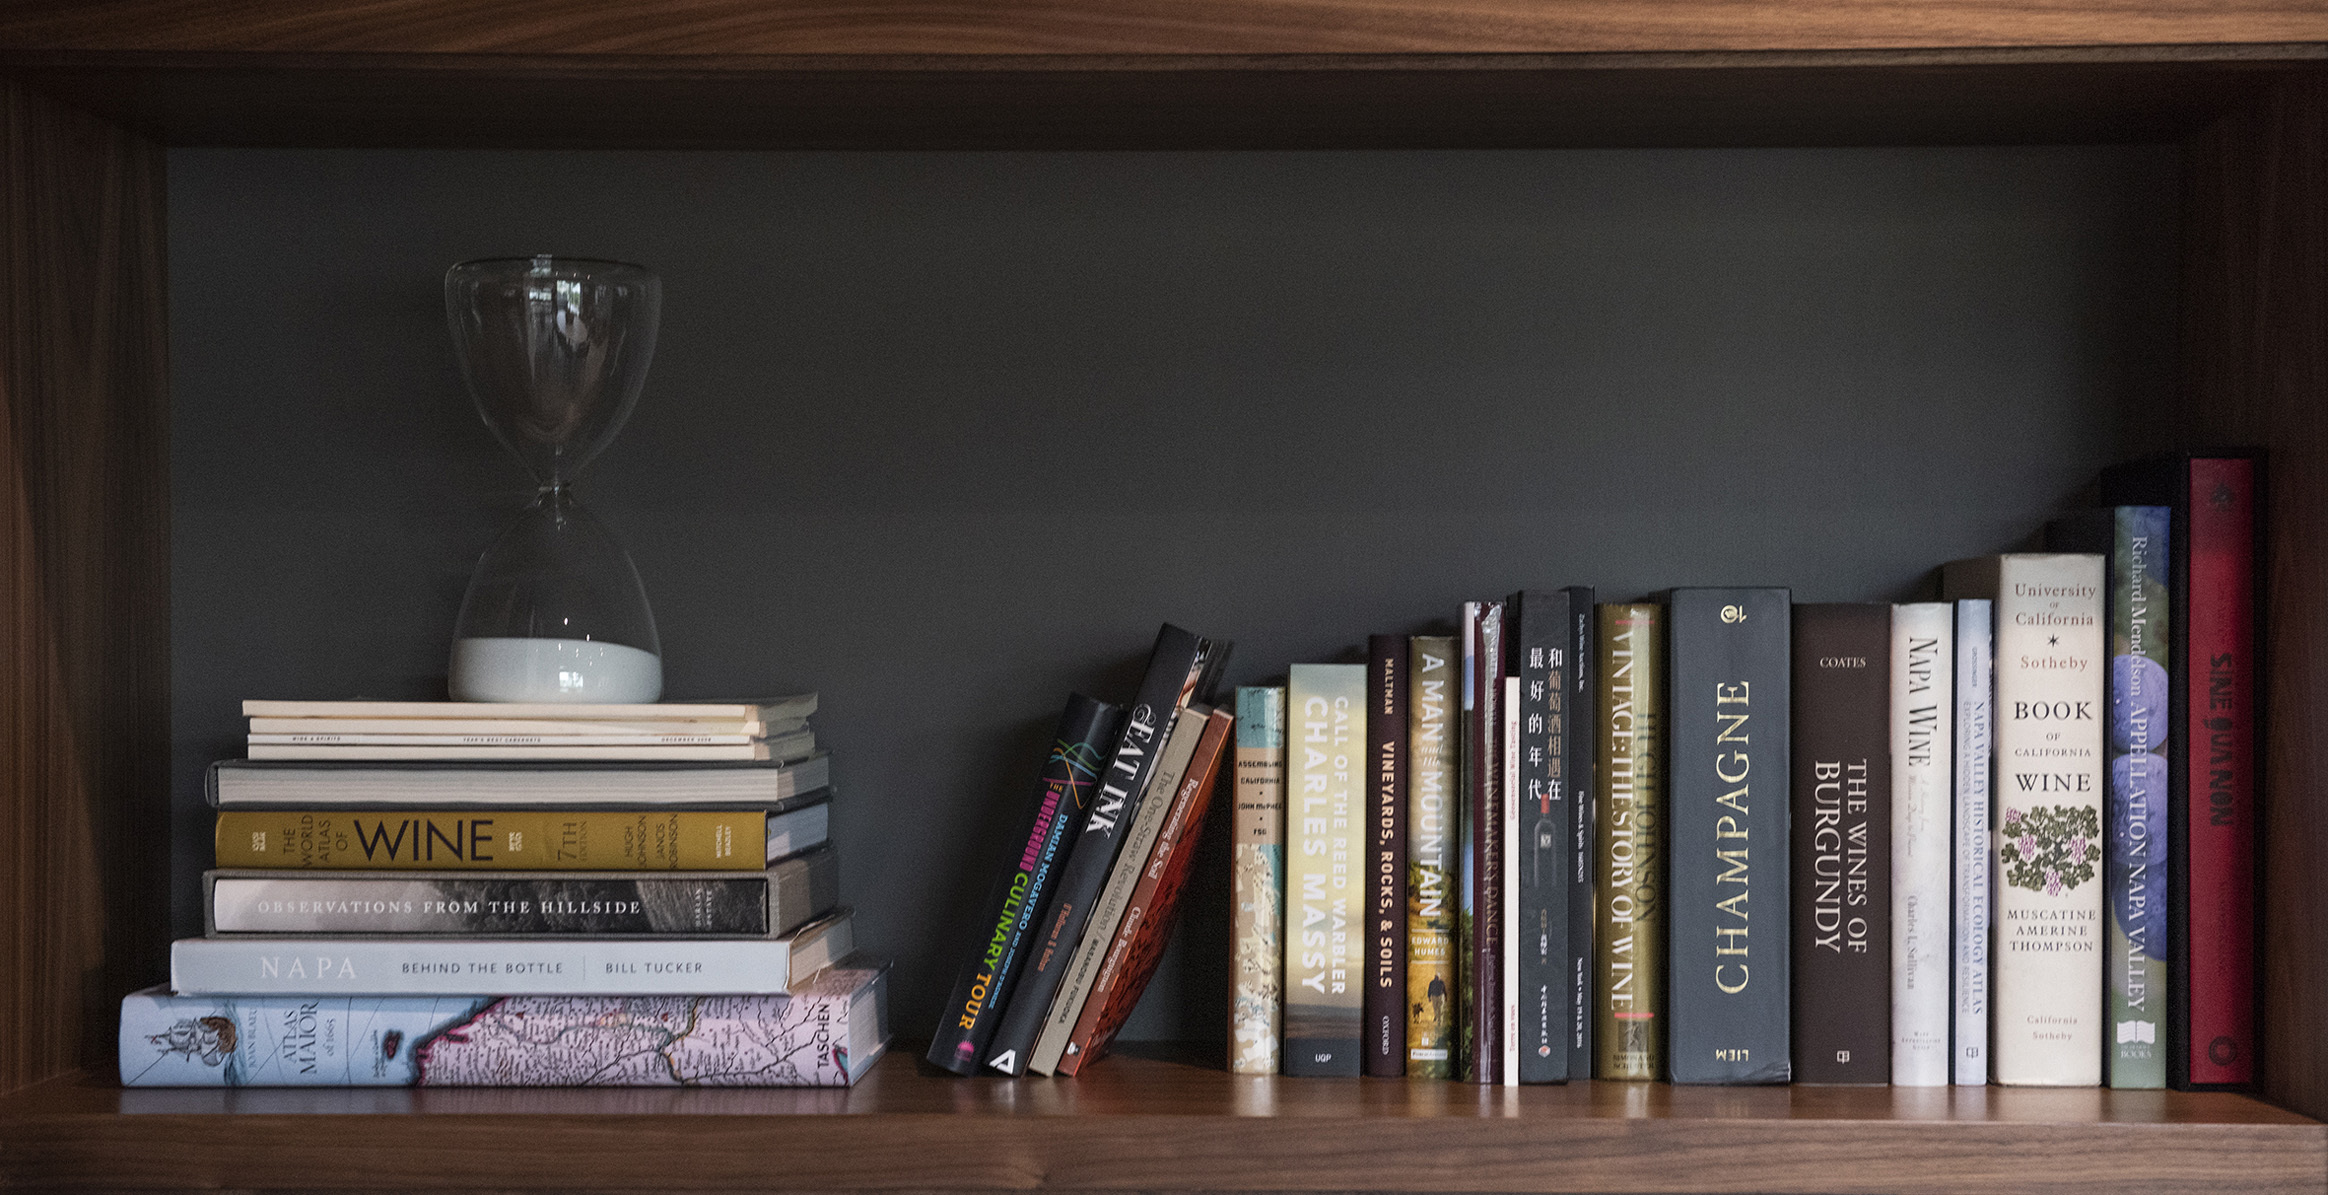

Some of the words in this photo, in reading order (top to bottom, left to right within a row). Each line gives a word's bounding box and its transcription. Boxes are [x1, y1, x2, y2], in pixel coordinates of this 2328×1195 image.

[2015, 583, 2097, 600] University
[2130, 536, 2148, 602] Richard
[2015, 612, 2094, 626] California
[1421, 653, 1445, 673] A
[1819, 656, 1867, 668] COATES
[1908, 635, 1938, 695] NAPA
[2020, 656, 2089, 670] Sotheby
[2130, 605, 2147, 696] Mendelson
[1384, 658, 1393, 716] MALTMAN
[1611, 630, 1633, 752] VINTAGE:
[2208, 652, 2232, 710] SINE
[1333, 696, 1349, 747] CALL
[1421, 680, 1445, 741] MAN
[1528, 647, 1544, 801] 最好的年代
[1547, 647, 1563, 801] 和葡萄酒相遇在
[1907, 703, 1937, 767] WINE
[1973, 701, 1984, 739] NAPA
[2014, 701, 2093, 720] BOOK
[2045, 732, 2061, 741] OF
[1113, 705, 1155, 781] EAT
[1238, 760, 1283, 768] ASSEMBLING
[1635, 712, 1656, 796] HUGH
[2014, 748, 2091, 757] CALIFORNIA
[2203, 717, 2233, 764] QUA
[1049, 781, 1063, 792] THE
[1155, 770, 1176, 795] The
[1240, 776, 1281, 785] CALIFORNIA
[1303, 696, 1328, 857] CHARLES
[1333, 754, 1349, 783] OF
[1380, 740, 1395, 847] VINEYARDS,
[1611, 754, 1633, 809] THE
[1846, 758, 1867, 814] THE
[1973, 743, 1984, 797] VALLEY
[2015, 773, 2092, 792] WINE
[2129, 701, 2148, 857] APPELLATION
[1086, 783, 1128, 838] INK
[1162, 778, 1199, 841] Regenerating
[1238, 802, 1255, 811] JOHN
[1333, 788, 1348, 823] THE
[2208, 769, 2233, 826] NON
[283, 827, 295, 854] THE
[300, 814, 313, 866] WORLD
[318, 819, 330, 862] ATLAS
[335, 831, 348, 851] OF
[353, 820, 493, 862] WINE
[557, 822, 577, 861] 7TH
[624, 826, 634, 857] HUGH
[636, 814, 647, 868] JOHNSON
[655, 823, 665, 859] JANCIS
[668, 813, 678, 868] ROBINSON
[1019, 790, 1060, 872] UNDERGROUND
[1044, 813, 1069, 862] DAMIAN
[1128, 795, 1164, 862] One-Straw
[1157, 841, 1170, 858] the
[1419, 771, 1443, 918] MOUNTAIN
[1610, 810, 1633, 889] STORY
[1716, 680, 1751, 995] CHAMPAGNE
[1972, 800, 1984, 888] HISTORICAL
[1147, 858, 1164, 880] Soil
[1332, 832, 1348, 890] REED
[1379, 850, 1394, 913] ROCKS,
[1634, 800, 1656, 922] JOHNSON
[1813, 761, 1842, 955] BURGUNDY
[1846, 821, 1867, 908] WINES
[257, 901, 413, 915] OBSERVATIONS
[423, 901, 483, 915] FROM
[489, 901, 531, 915] THE
[540, 901, 641, 915] HILLSIDE
[1018, 862, 1050, 931] MOGAVERO
[1097, 862, 1136, 931] Revolution
[1485, 885, 1498, 945] DANCE
[1610, 892, 1633, 929] OF
[1906, 895, 1917, 932] Charles
[2007, 909, 2097, 921] MUSCATINE
[2128, 863, 2147, 921] NAPA
[983, 872, 1029, 972] CULINARY
[1122, 906, 1142, 938] Claude
[1302, 873, 1327, 995] MASSY
[1331, 900, 1348, 995] WARBLER
[1379, 917, 1394, 933] &
[1411, 936, 1449, 945] EDWARD
[1846, 913, 1867, 954] OF
[1972, 895, 1983, 965] ECOLOGY
[2009, 941, 2094, 952] THOMPSON
[2016, 925, 2088, 937] AMERINE
[261, 957, 357, 980] NAPA
[402, 962, 461, 974] BEHIND
[468, 962, 499, 974] THE
[505, 962, 564, 974] BOTTLE
[605, 962, 638, 974] BILL
[644, 962, 703, 974] TUCKER
[1075, 938, 1099, 985] MASANOBU
[1097, 938, 1128, 993] Bourguignon
[1379, 936, 1394, 989] SOILS
[1414, 947, 1446, 957] HUMES
[1610, 933, 1633, 1011] WINE
[1906, 946, 1917, 990] Sullivan
[2127, 925, 2147, 1012] VALLEY
[958, 973, 993, 1030] TOUR
[1058, 985, 1080, 1024] FUKUOKA
[1972, 969, 1983, 1015] ATLAS
[282, 1009, 297, 1063] ATLAS
[298, 1000, 319, 1074] MAIOR
[817, 1003, 832, 1070] TASCHEN
[1381, 1015, 1390, 1056] OXFORD
[2027, 1015, 2078, 1025] California
[2032, 1031, 2073, 1041] Sotheby
[1315, 1052, 1332, 1063] UQP
[1715, 1049, 1749, 1062] LIEM
